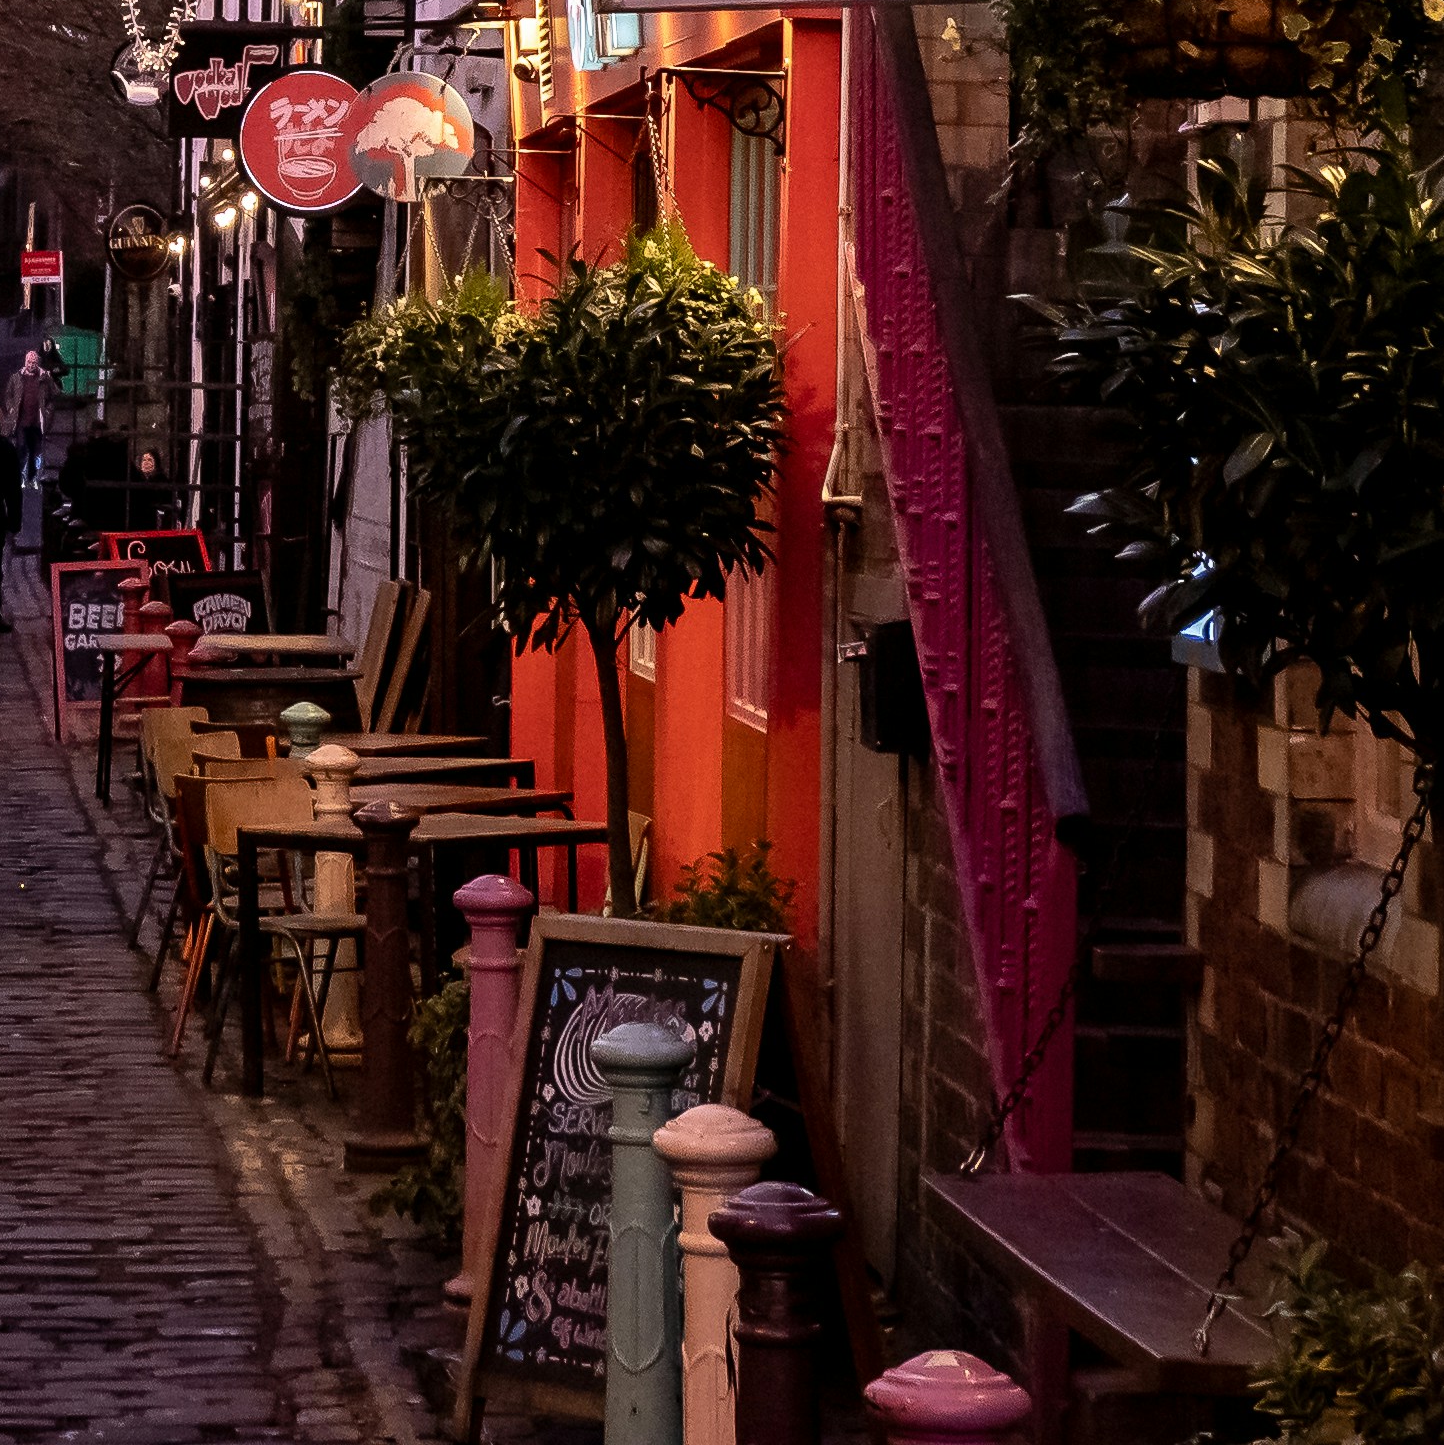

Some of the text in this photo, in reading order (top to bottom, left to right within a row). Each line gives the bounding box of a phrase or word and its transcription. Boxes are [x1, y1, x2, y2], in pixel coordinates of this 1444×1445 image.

[270, 97, 349, 129] ラーメン
[193, 593, 252, 622] RAMEN
